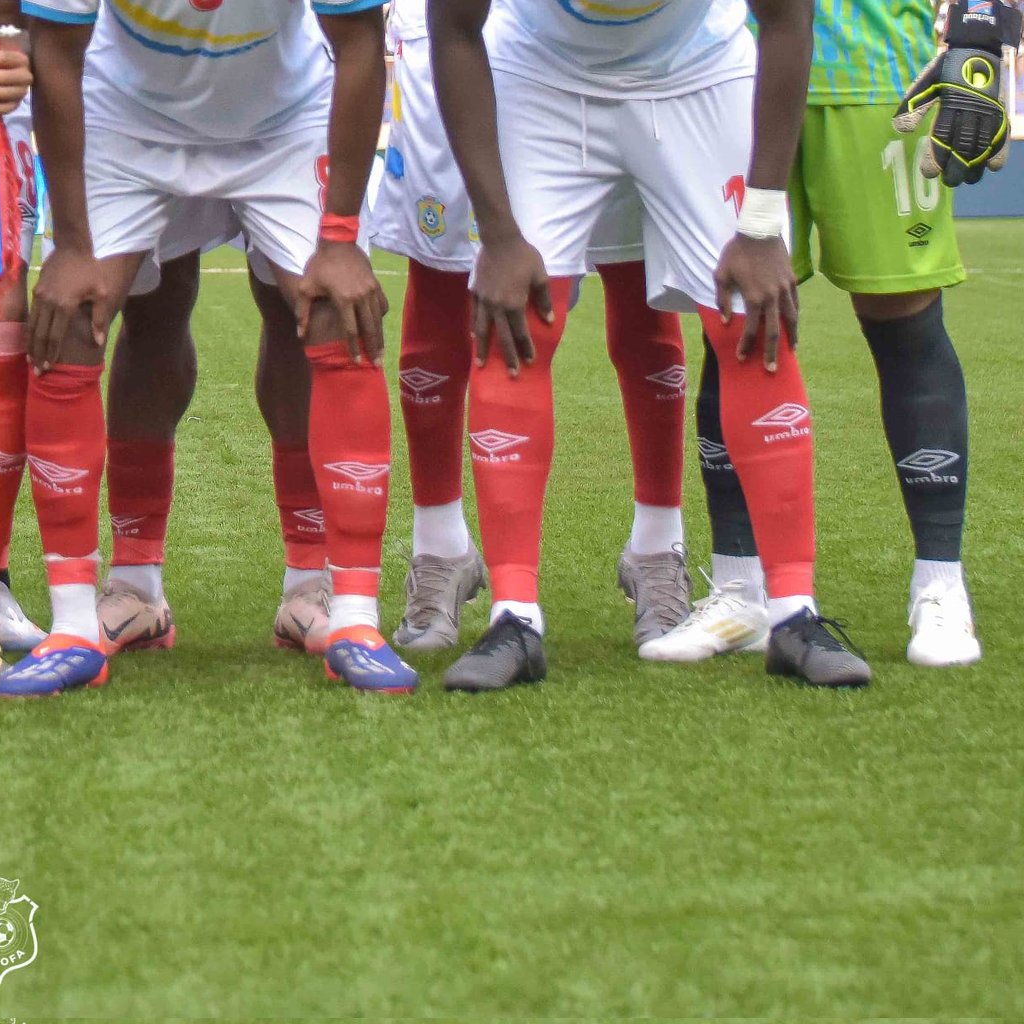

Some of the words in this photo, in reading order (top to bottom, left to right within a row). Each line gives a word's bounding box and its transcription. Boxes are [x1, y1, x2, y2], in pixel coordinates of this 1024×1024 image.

[905, 472, 958, 484] umbro
[332, 481, 383, 495] umbro
[297, 524, 325, 533] umb
